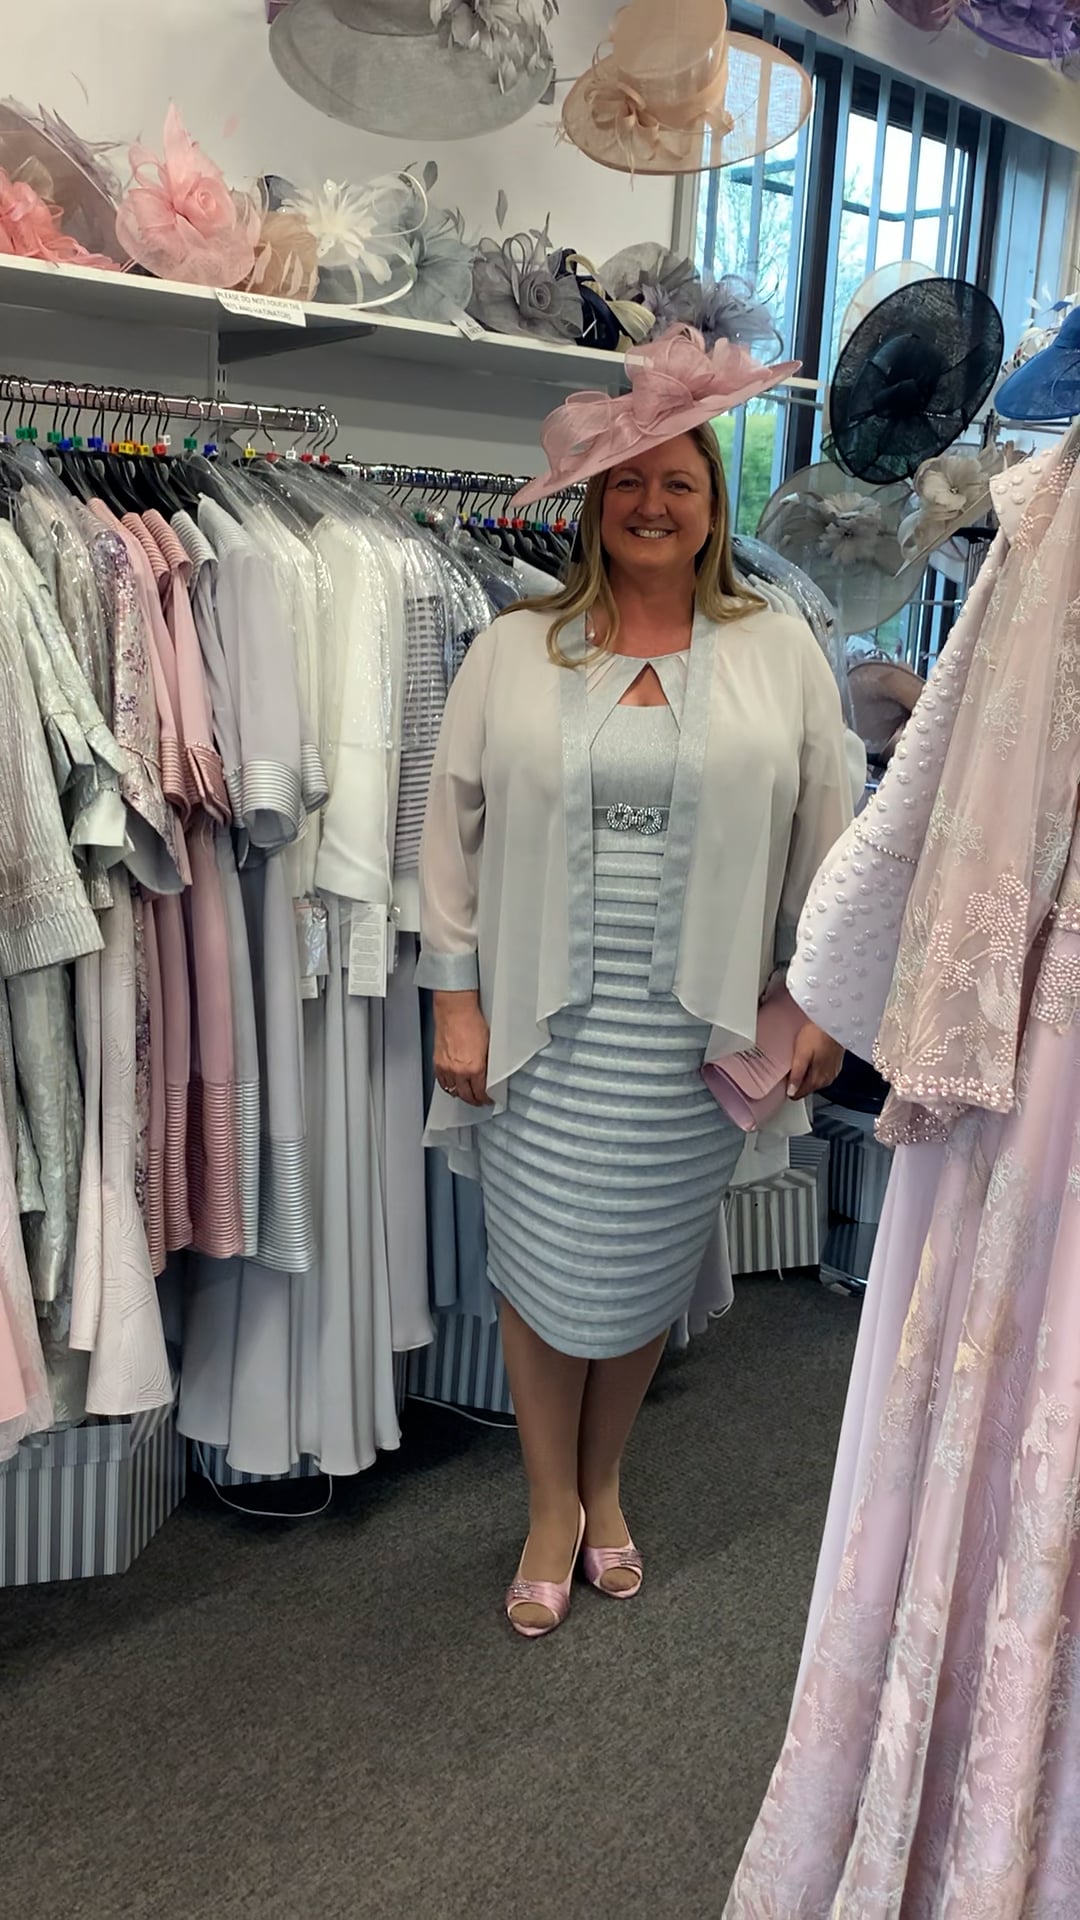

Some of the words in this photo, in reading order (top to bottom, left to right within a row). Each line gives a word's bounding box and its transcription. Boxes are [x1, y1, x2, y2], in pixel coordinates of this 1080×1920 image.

[217, 291, 239, 300] PLEASE
[241, 295, 251, 303] DO
[252, 297, 266, 305] NOT
[267, 299, 288, 308] TOUCH
[289, 302, 301, 310] THE
